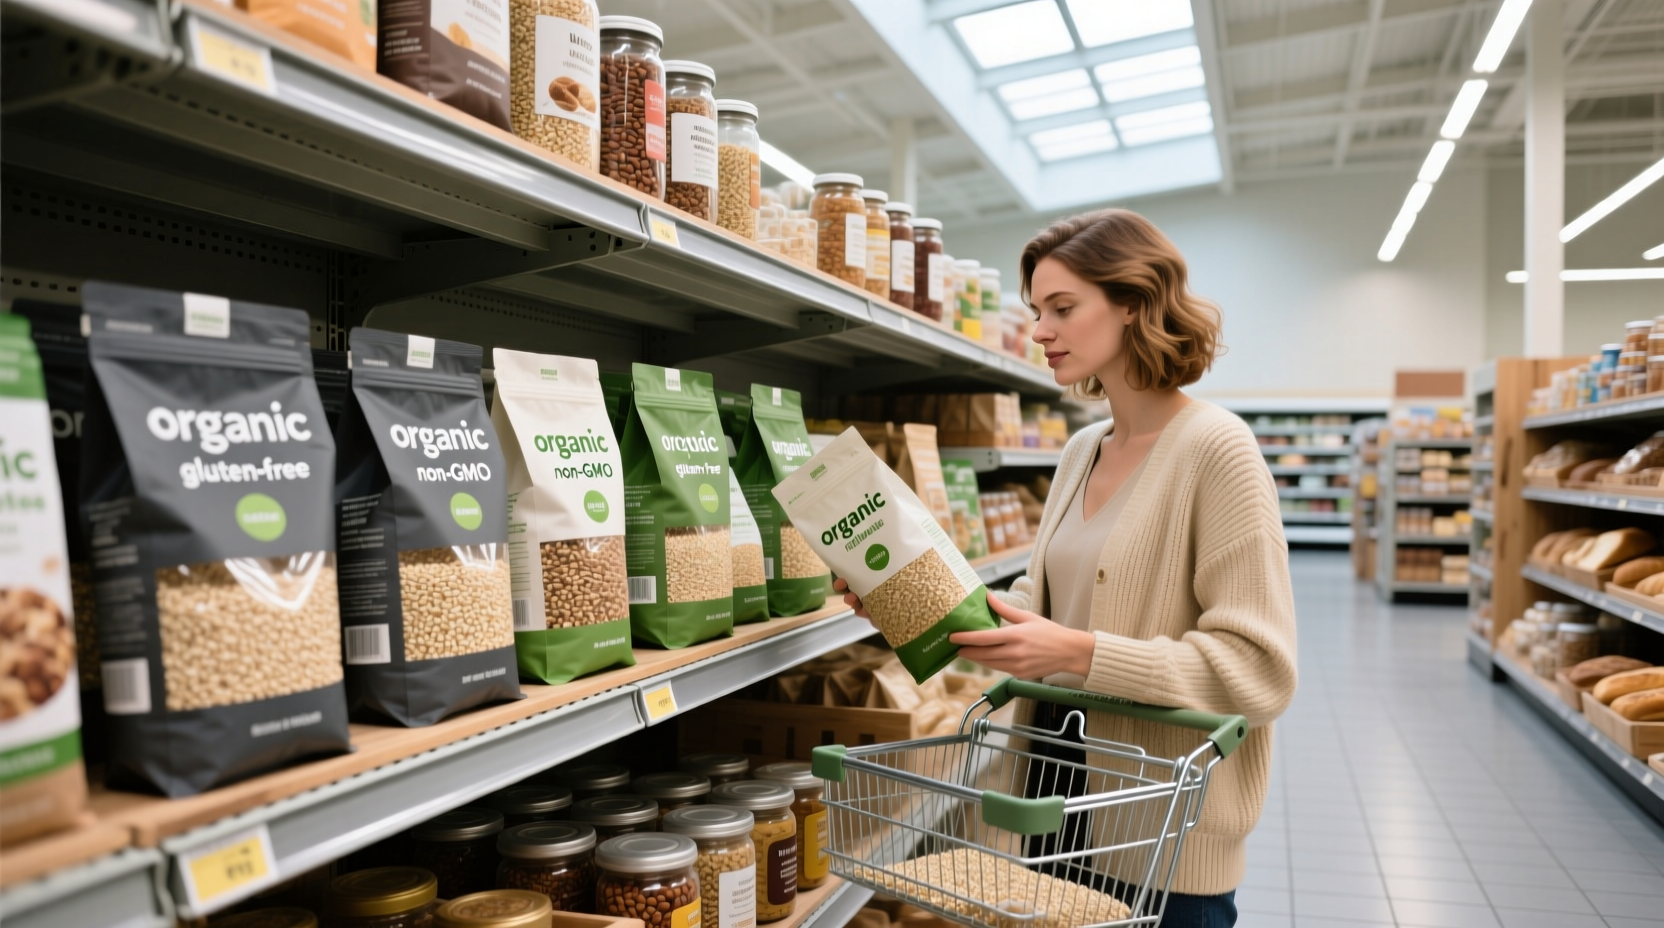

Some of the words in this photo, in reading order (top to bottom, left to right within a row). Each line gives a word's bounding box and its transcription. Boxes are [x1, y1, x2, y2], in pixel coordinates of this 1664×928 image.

[146, 400, 312, 455] organic
[390, 420, 489, 458] organic
[534, 428, 609, 459] organic
[179, 456, 311, 489] gluten-free
[416, 463, 491, 482] non-GMO
[554, 462, 613, 479] non-GMO
[821, 492, 886, 546] organic
